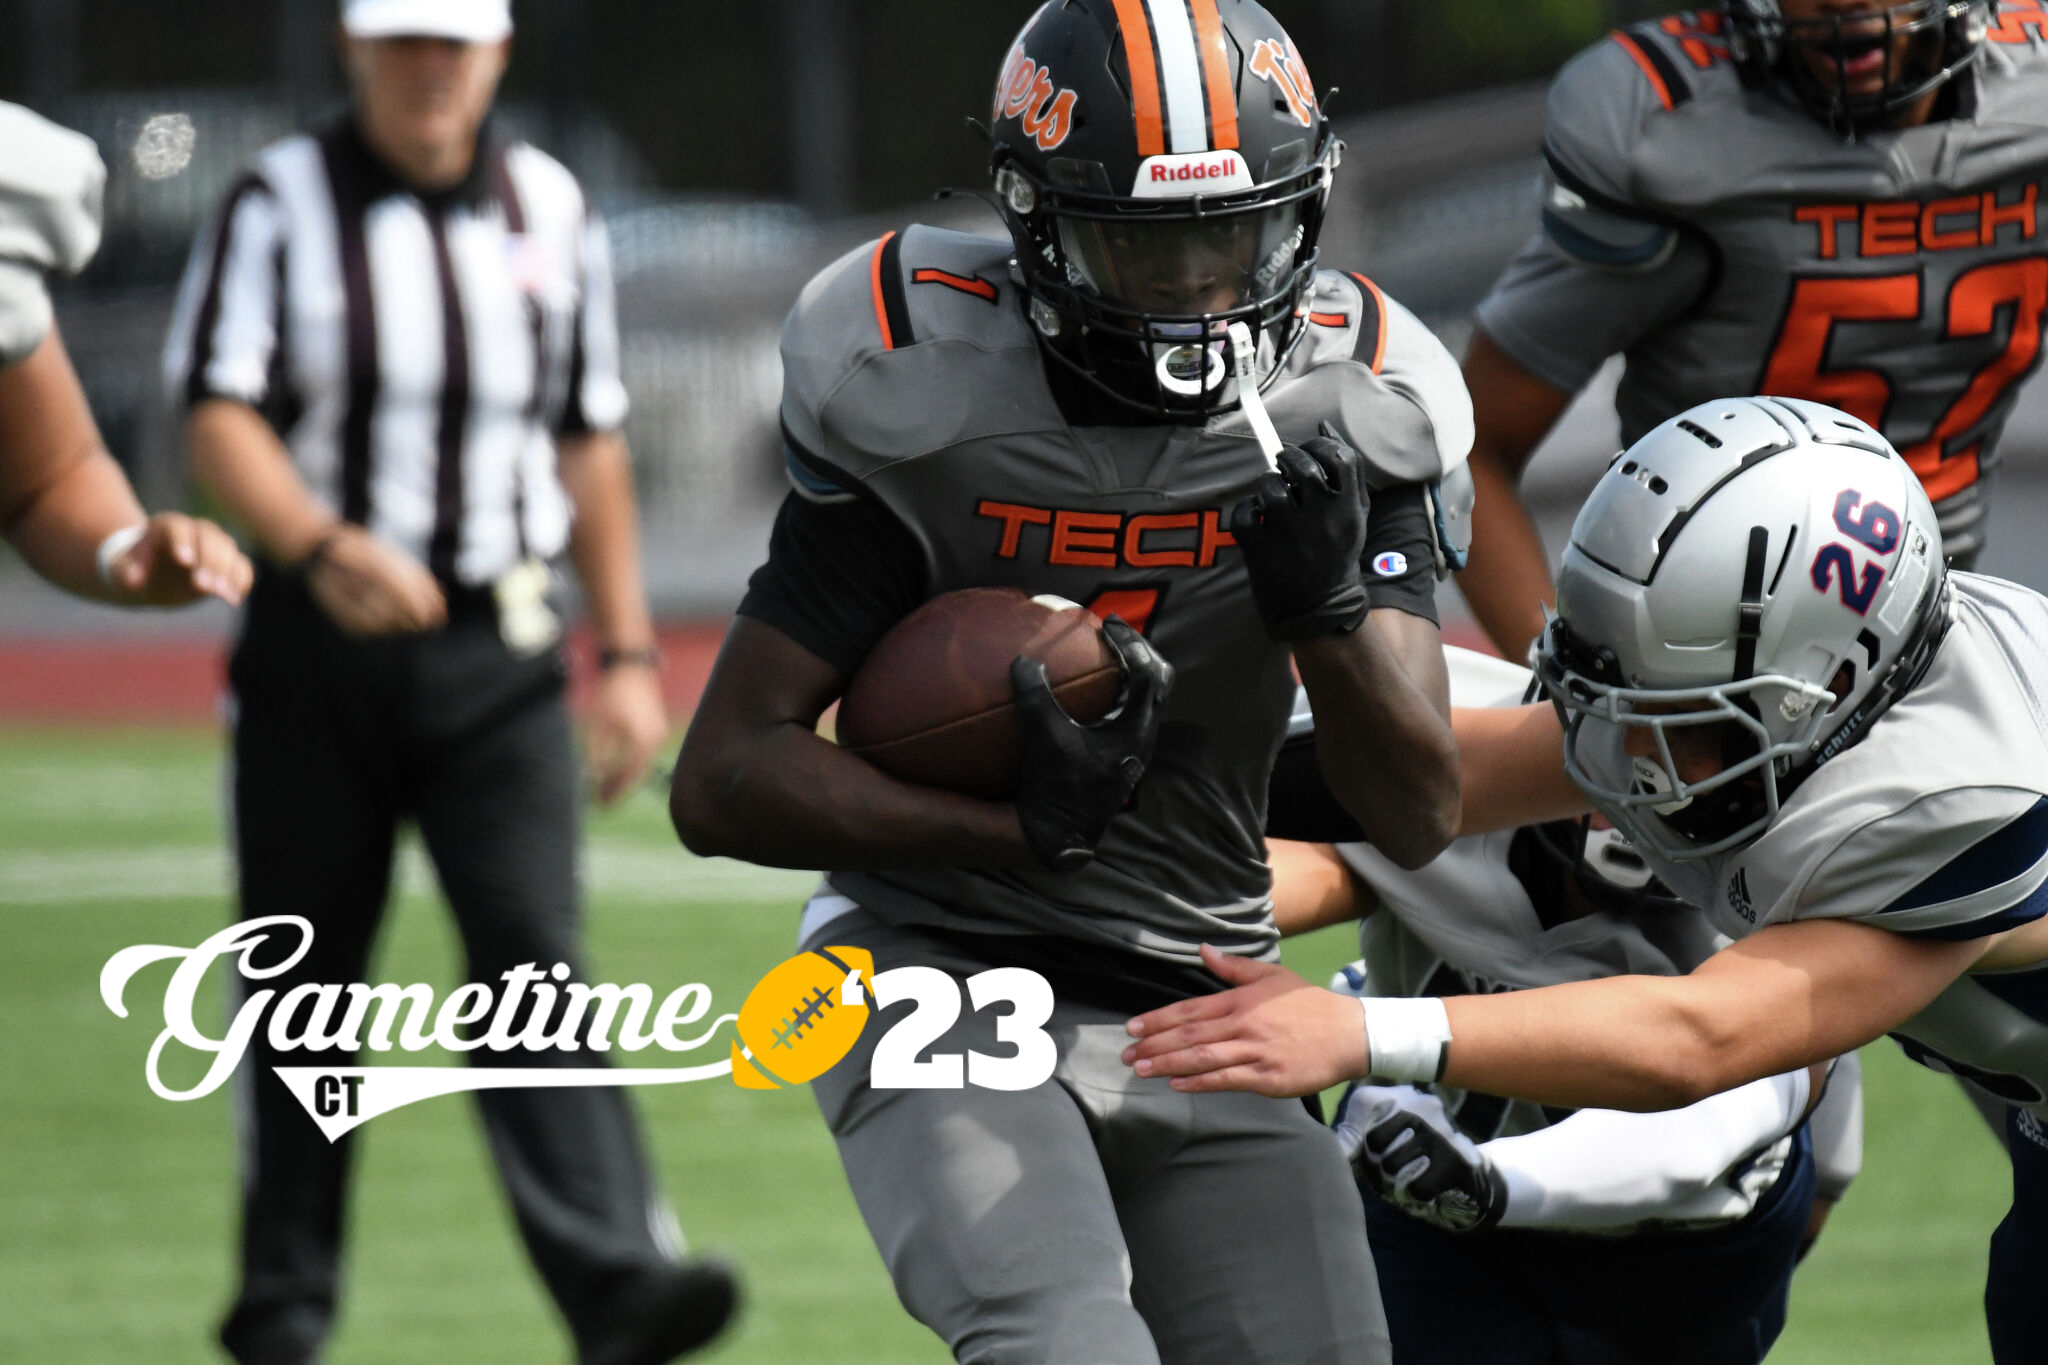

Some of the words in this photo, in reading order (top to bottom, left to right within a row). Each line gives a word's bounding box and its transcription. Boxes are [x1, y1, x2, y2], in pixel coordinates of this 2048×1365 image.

[1150, 158, 1236, 182] Riddell
[1794, 182, 2039, 260] TECH
[1757, 256, 2048, 502] 52
[1809, 487, 1903, 617] 26
